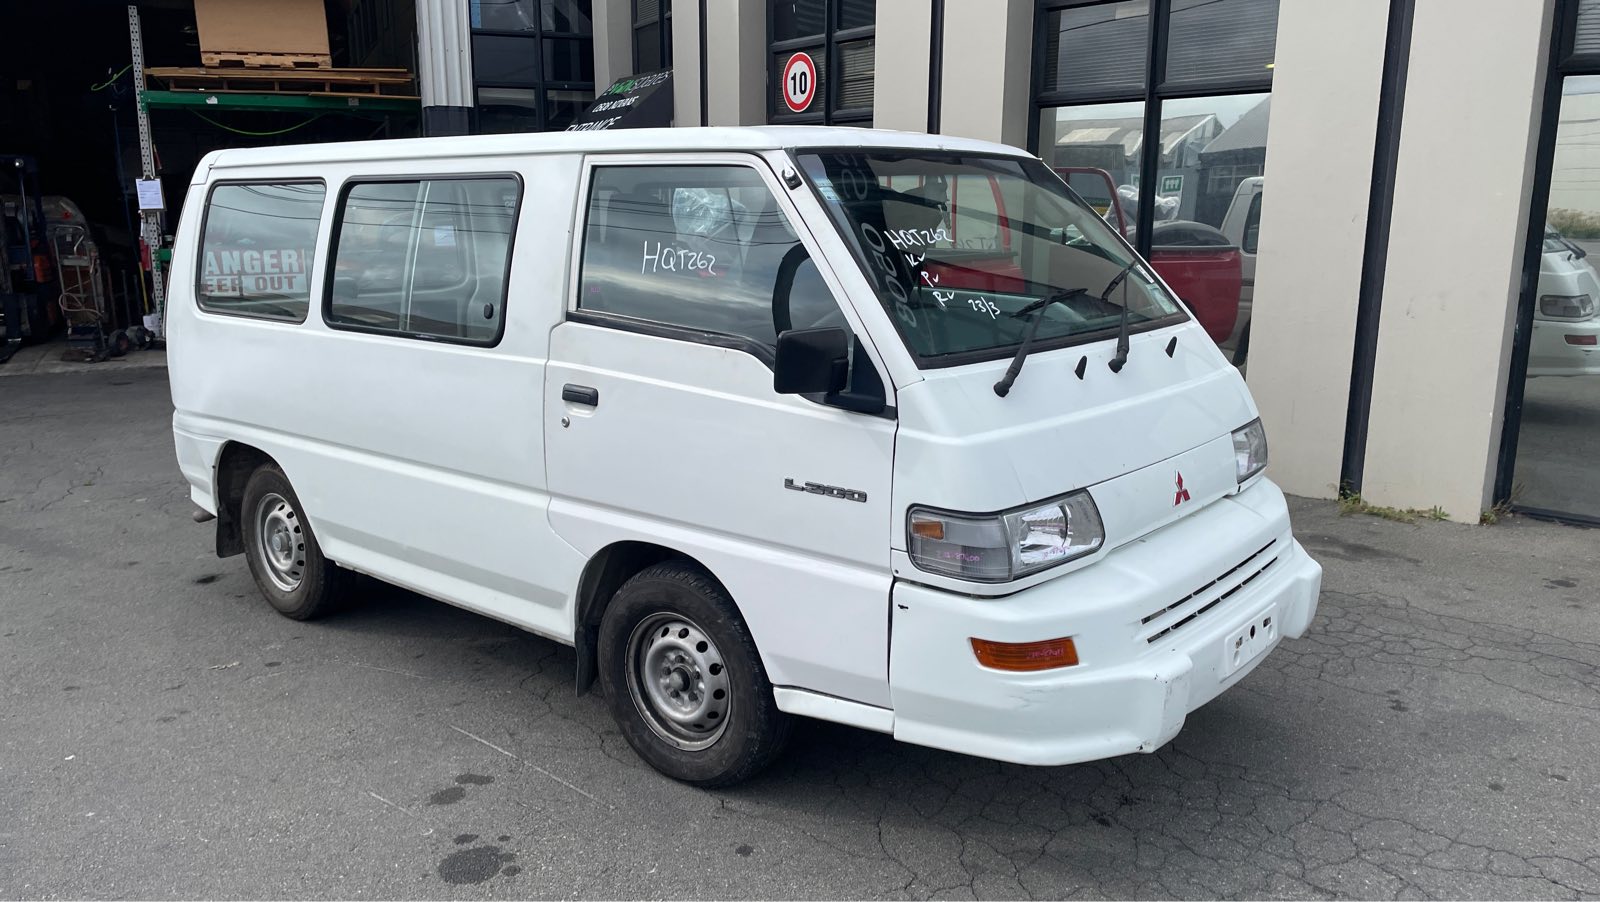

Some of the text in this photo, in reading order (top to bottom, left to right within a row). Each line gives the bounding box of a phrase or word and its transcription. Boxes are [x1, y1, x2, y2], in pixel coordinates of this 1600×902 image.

[791, 71, 808, 95] 10
[884, 228, 954, 250] HQT262
[204, 249, 300, 275] ANGER
[642, 241, 717, 276] HQT262
[202, 275, 297, 292] EEP OUT
[968, 296, 1001, 320] 23/3
[784, 477, 868, 503] L300
